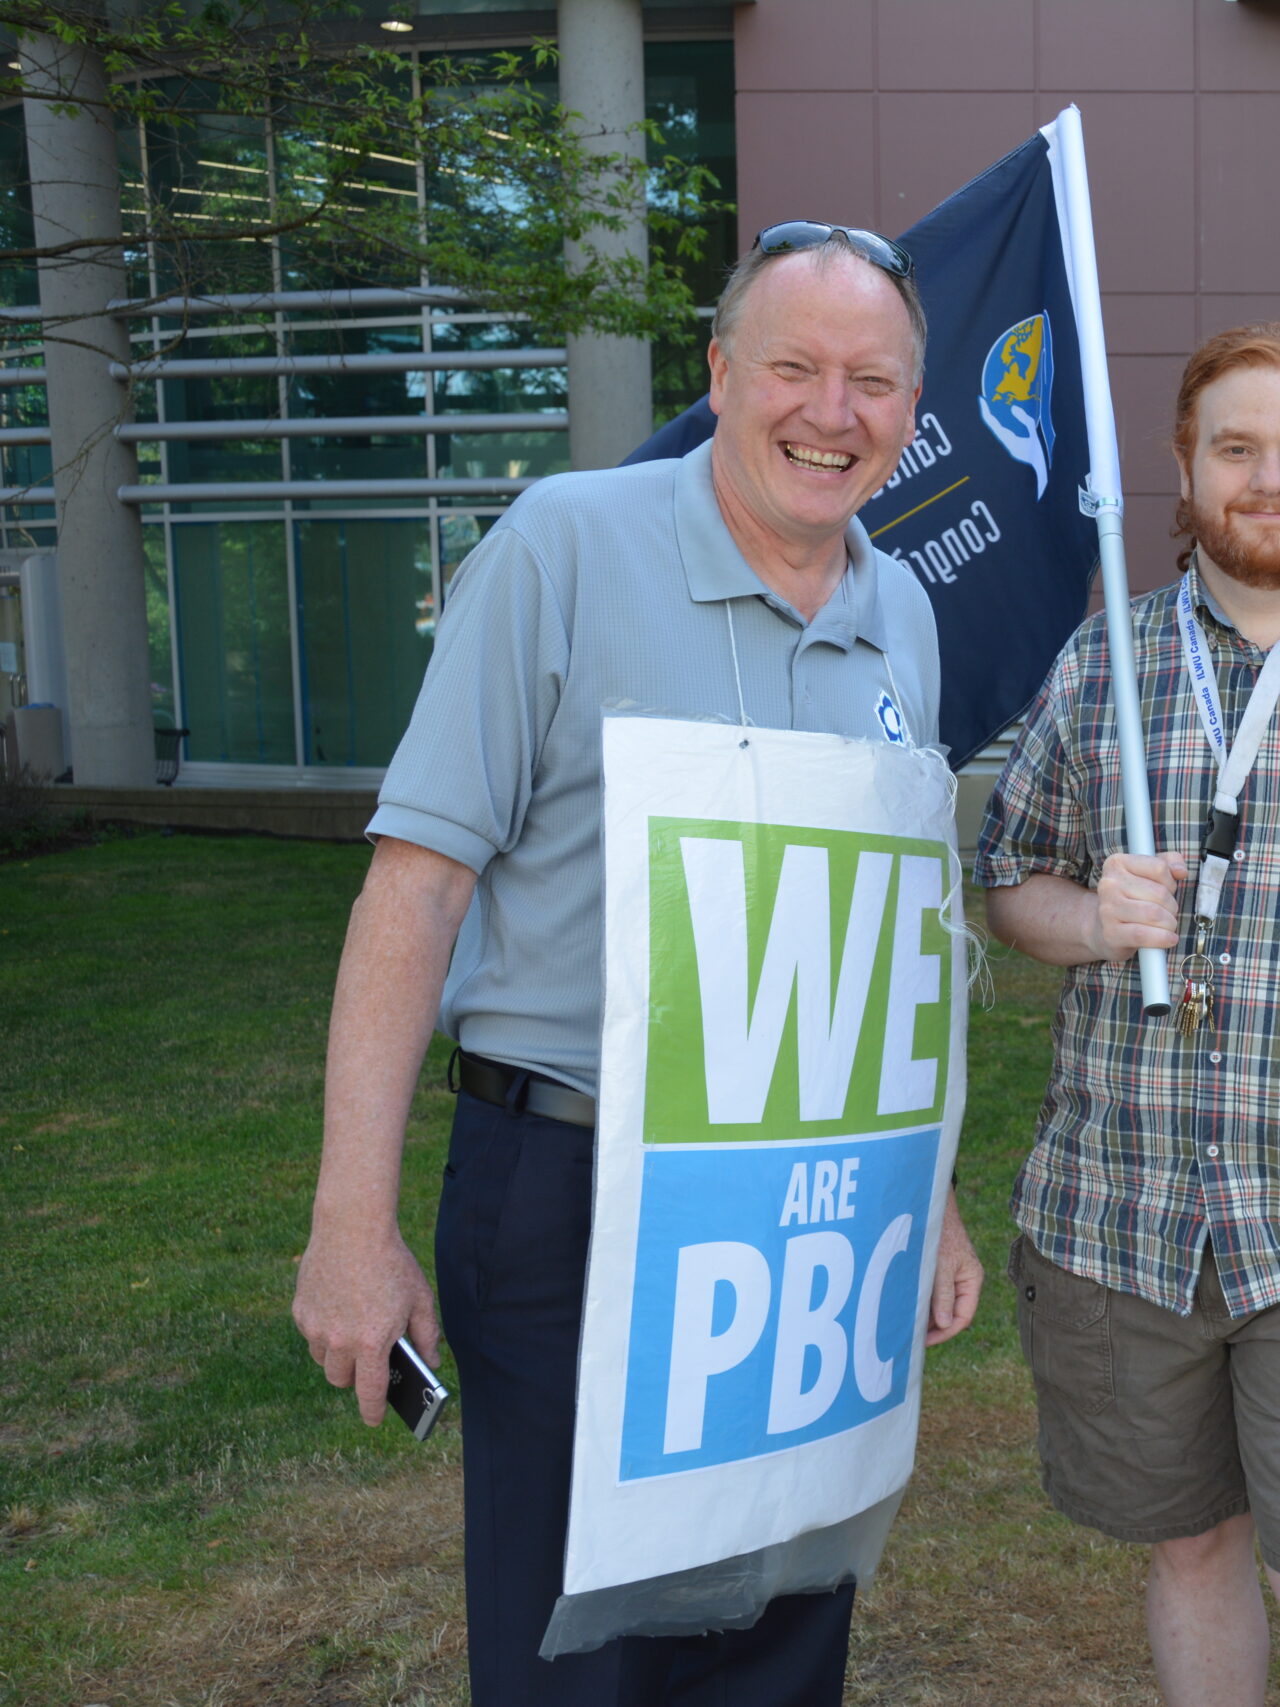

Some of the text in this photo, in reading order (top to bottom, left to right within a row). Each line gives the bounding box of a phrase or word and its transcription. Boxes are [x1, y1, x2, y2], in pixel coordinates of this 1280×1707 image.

[1181, 590, 1191, 614] ILWU
[1186, 619, 1199, 654] Canada
[1192, 655, 1206, 681] ILWU
[1202, 687, 1218, 726] Canada
[679, 836, 943, 1125] WE
[778, 1157, 861, 1228] ARE
[662, 1213, 914, 1456] PBC
